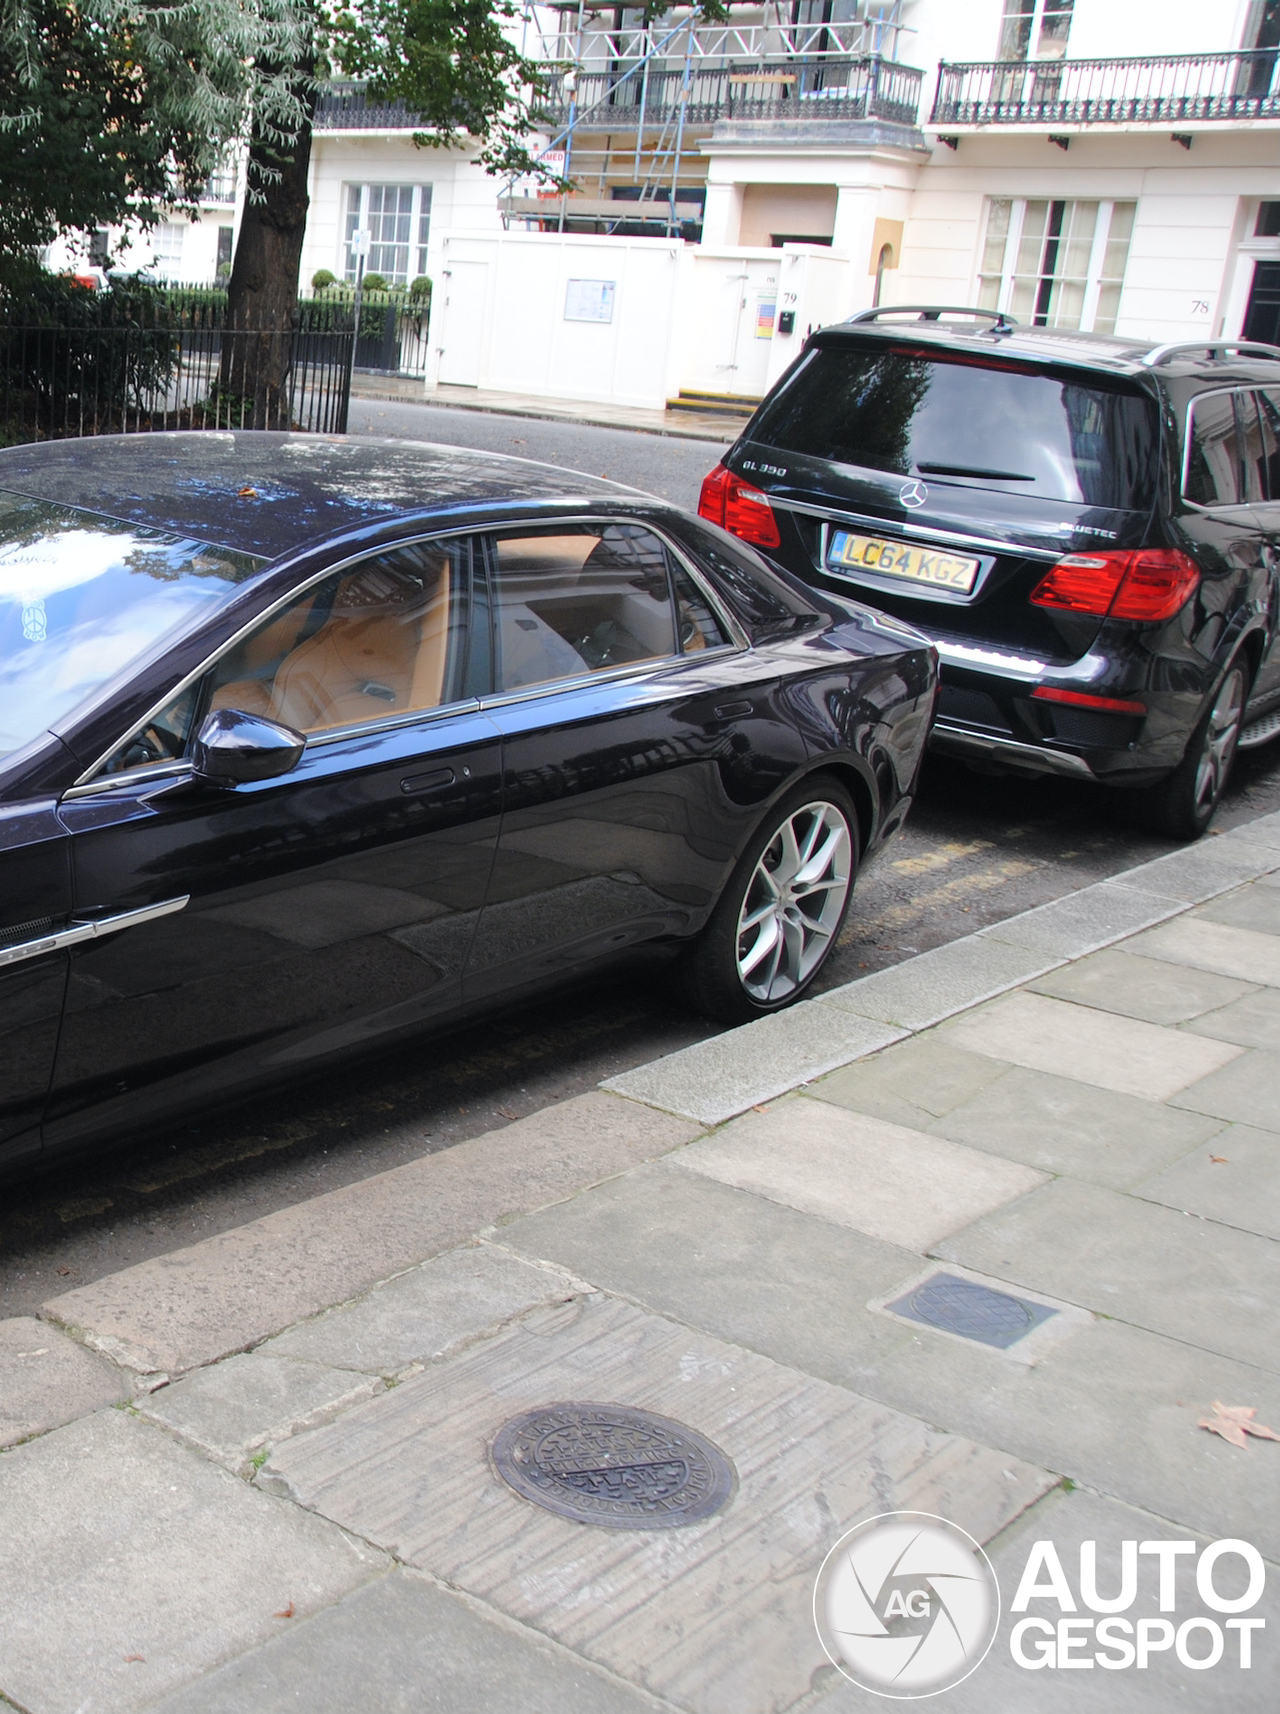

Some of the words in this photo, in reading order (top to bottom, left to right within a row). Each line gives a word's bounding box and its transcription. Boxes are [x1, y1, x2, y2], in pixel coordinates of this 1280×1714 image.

[784, 292, 798, 304] 79
[1191, 301, 1209, 314] 78
[742, 460, 757, 471] GL
[758, 463, 787, 477] 350
[1059, 522, 1118, 539] BLUETEC
[845, 539, 910, 573] LC64
[916, 553, 970, 585] KGZ
[660, 1462, 708, 1510] LONDON
